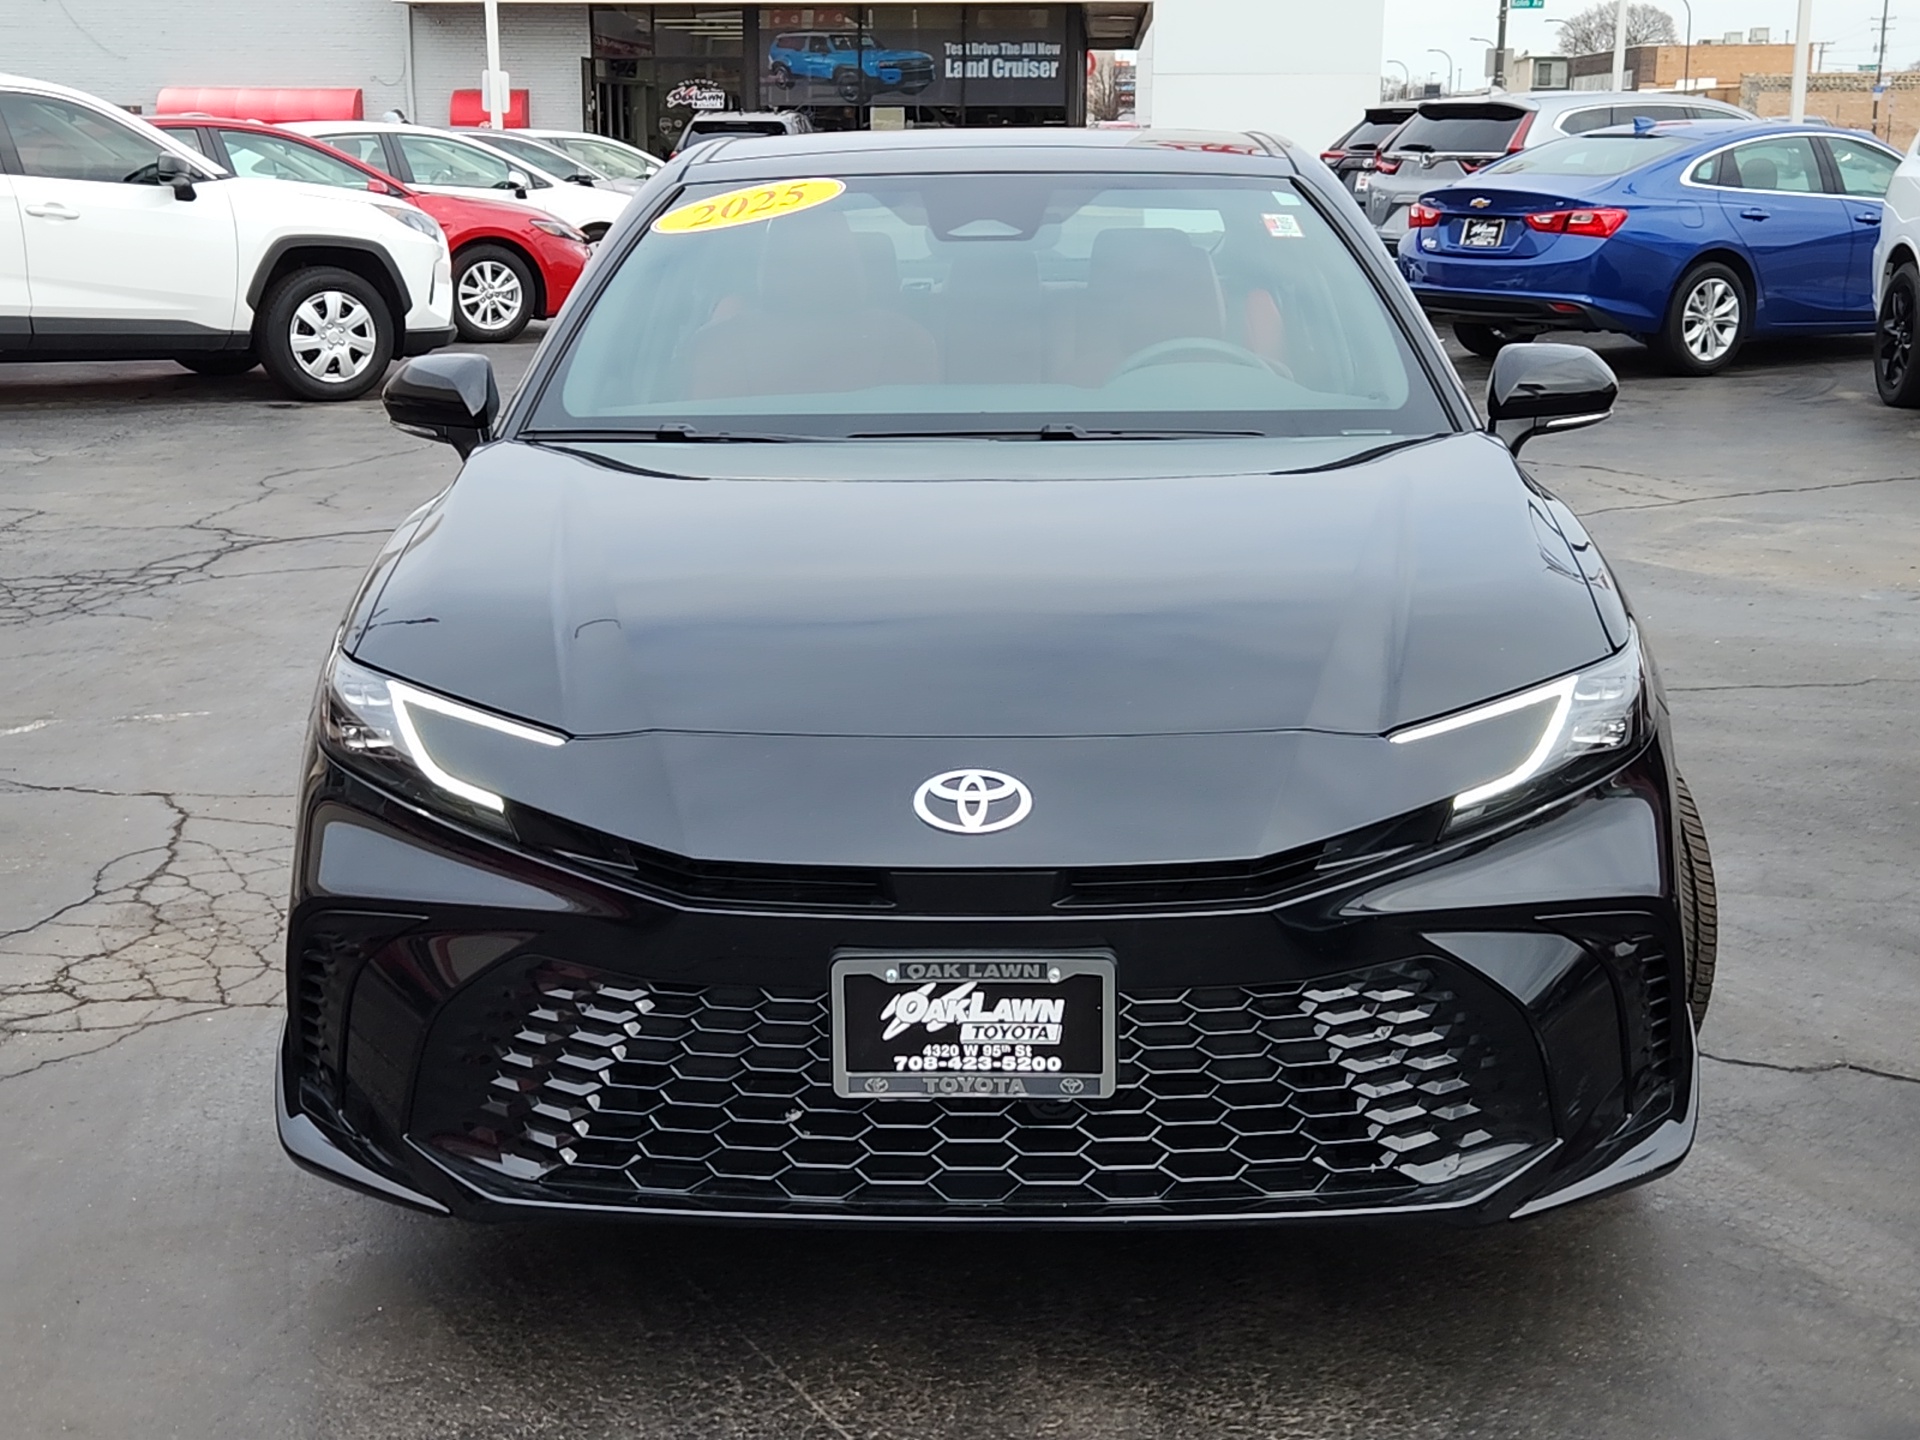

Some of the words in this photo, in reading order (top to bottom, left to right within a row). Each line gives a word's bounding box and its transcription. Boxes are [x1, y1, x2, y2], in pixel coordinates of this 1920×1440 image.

[944, 42, 970, 55] Test
[971, 42, 999, 55] Drive
[1000, 42, 1020, 55] The
[1022, 42, 1036, 55] All
[1038, 42, 1061, 55] New
[945, 58, 989, 78] Land
[992, 58, 1059, 78] Cruiser
[688, 183, 808, 228] 2025
[907, 964, 961, 979] OAK
[968, 964, 1040, 978] LAWN
[971, 1025, 1050, 1039] TOYOTA
[922, 1044, 960, 1057] 4320
[963, 1044, 979, 1057] W
[982, 1044, 1012, 1057] 95th
[1015, 1044, 1032, 1057] St
[893, 1055, 1062, 1071] 708-423-5200
[922, 1077, 1027, 1093] TOYOTA
